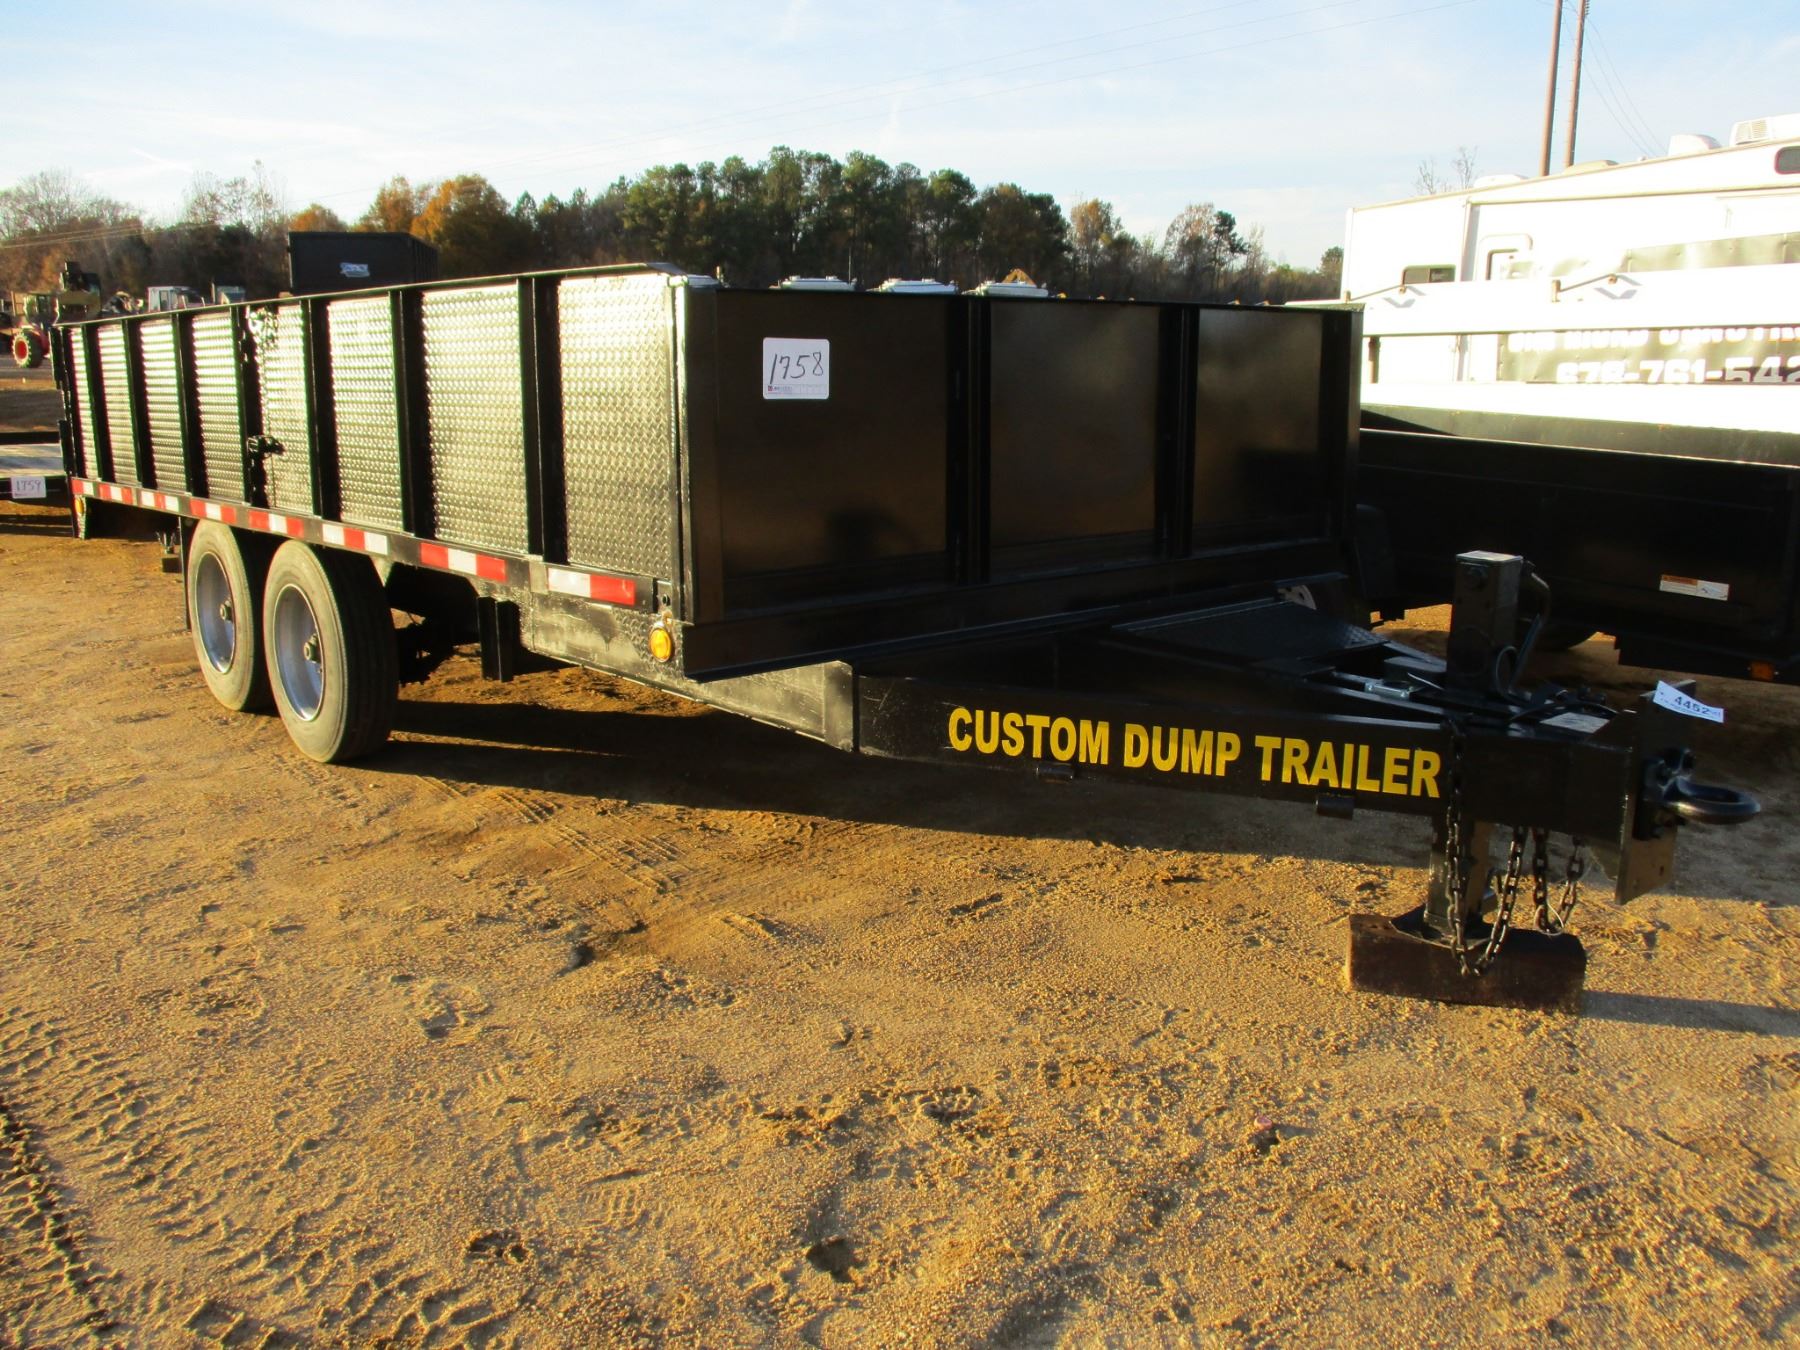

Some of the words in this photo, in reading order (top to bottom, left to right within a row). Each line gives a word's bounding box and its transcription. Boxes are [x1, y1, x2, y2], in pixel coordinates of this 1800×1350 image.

[769, 351, 824, 385] 1758
[1674, 695, 1711, 715] 4452
[948, 707, 1110, 766] CUSTOM
[1123, 723, 1242, 777] DUMP
[1255, 735, 1441, 799] TRAILER
